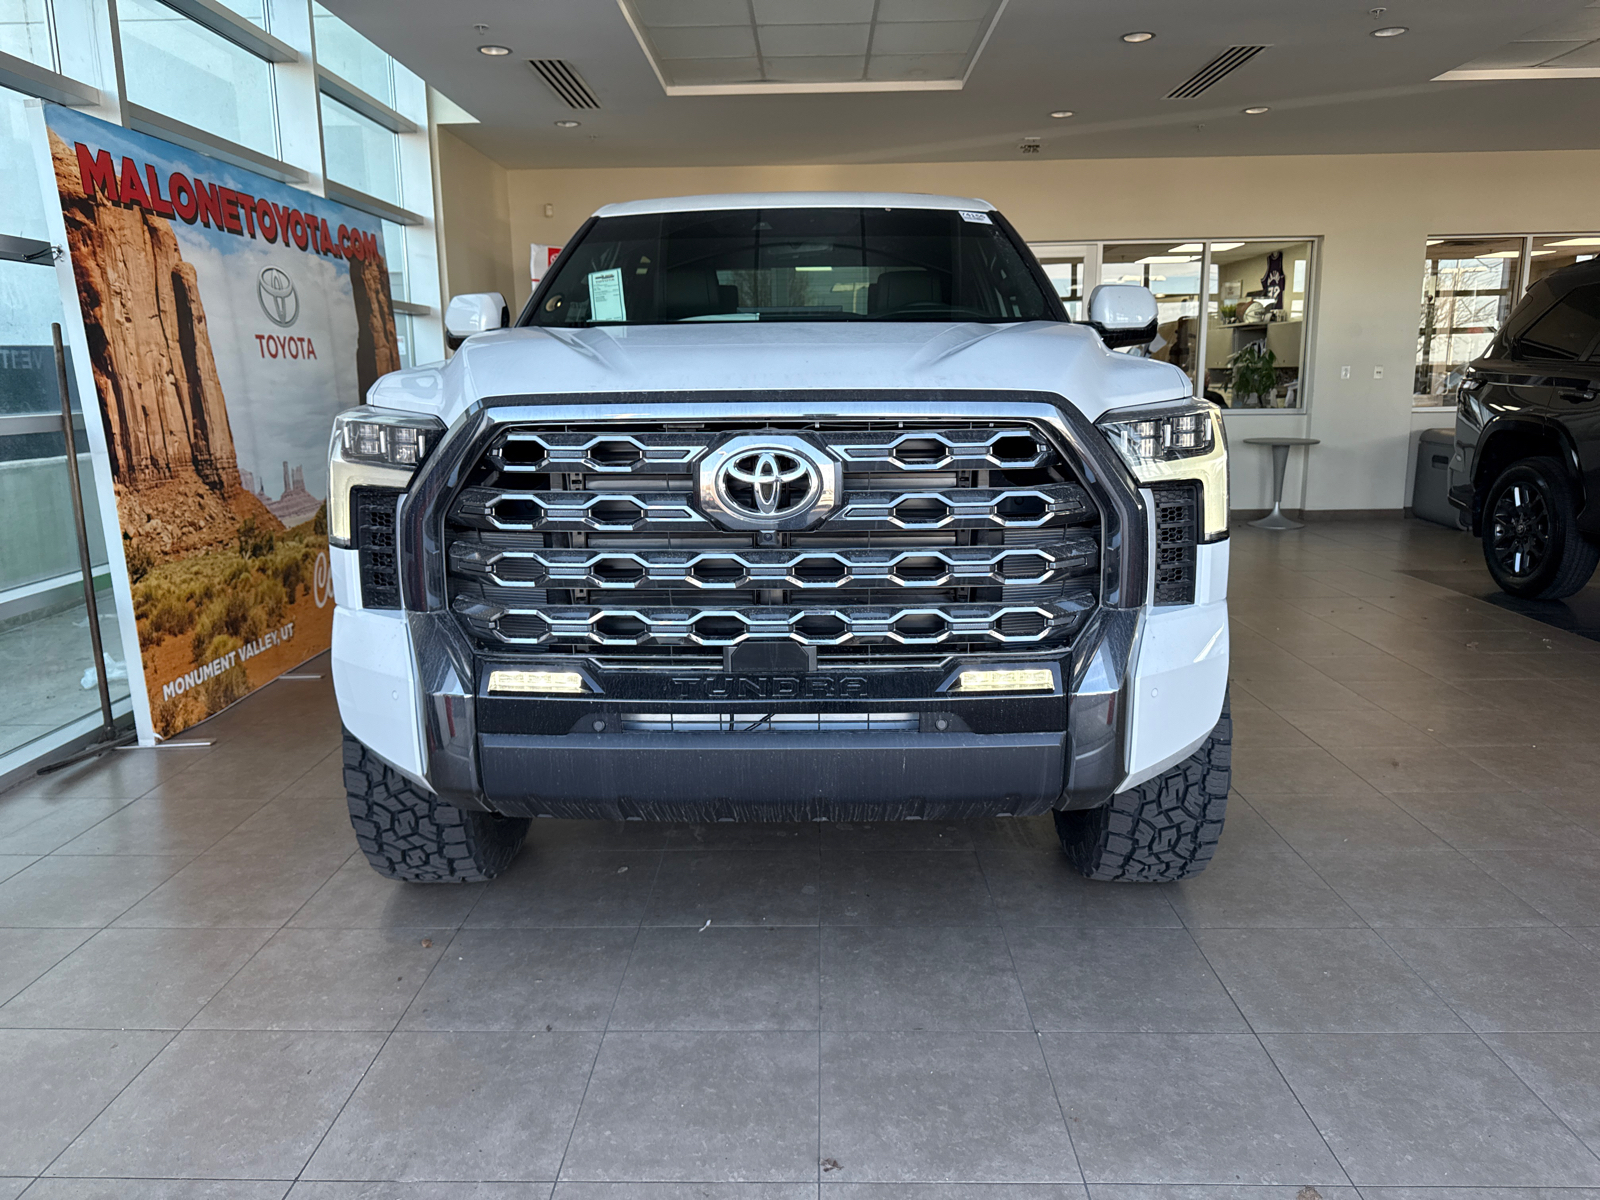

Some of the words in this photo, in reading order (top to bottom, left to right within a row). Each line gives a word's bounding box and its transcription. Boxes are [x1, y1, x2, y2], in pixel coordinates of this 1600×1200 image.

[75, 141, 382, 264] MALONETOYOTA.COM
[254, 334, 318, 361] TOYOTA
[162, 651, 237, 702] MONUMENT
[237, 629, 281, 663] VALLEY,
[280, 622, 295, 642] UT
[671, 676, 869, 697] TUNDRA
